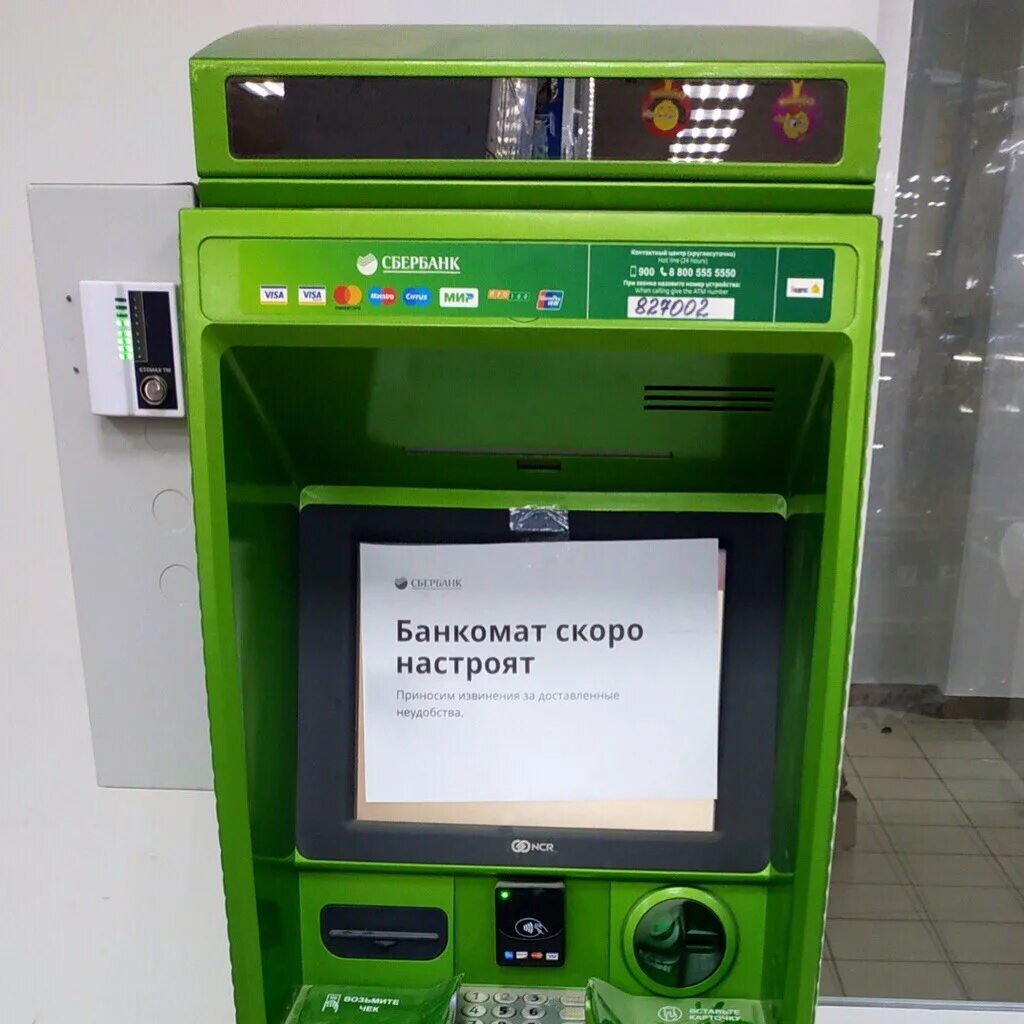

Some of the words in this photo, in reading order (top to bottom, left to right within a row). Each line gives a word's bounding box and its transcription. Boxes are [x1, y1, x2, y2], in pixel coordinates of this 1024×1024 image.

[381, 255, 461, 271] СБЕРБАНК
[638, 267, 655, 277] 900
[668, 267, 676, 277] 8
[676, 267, 694, 277] 800
[695, 268, 713, 278] 555
[714, 268, 737, 278] 5550
[265, 290, 285, 299] VISA
[303, 290, 322, 299] VISA
[405, 293, 428, 301] Cirrus
[444, 292, 474, 303] МИР
[635, 296, 709, 318] 827002
[411, 577, 463, 589] СБЕРБАНК
[396, 619, 547, 643] Банкомат
[556, 622, 644, 648] скоро
[396, 655, 535, 682] настроят
[396, 689, 456, 704] Приносим
[458, 691, 520, 701] извинения
[523, 691, 536, 701] за
[538, 691, 620, 703] доставленные
[396, 707, 464, 719] неудобства.
[531, 842, 554, 852] NCR
[343, 995, 400, 1006] ВОЗЬМИТЕ
[359, 1005, 380, 1013] ЧЕК
[500, 1007, 508, 1015] 5
[529, 1008, 538, 1016] 6
[688, 1014, 742, 1022] КАРТОЧКУ
